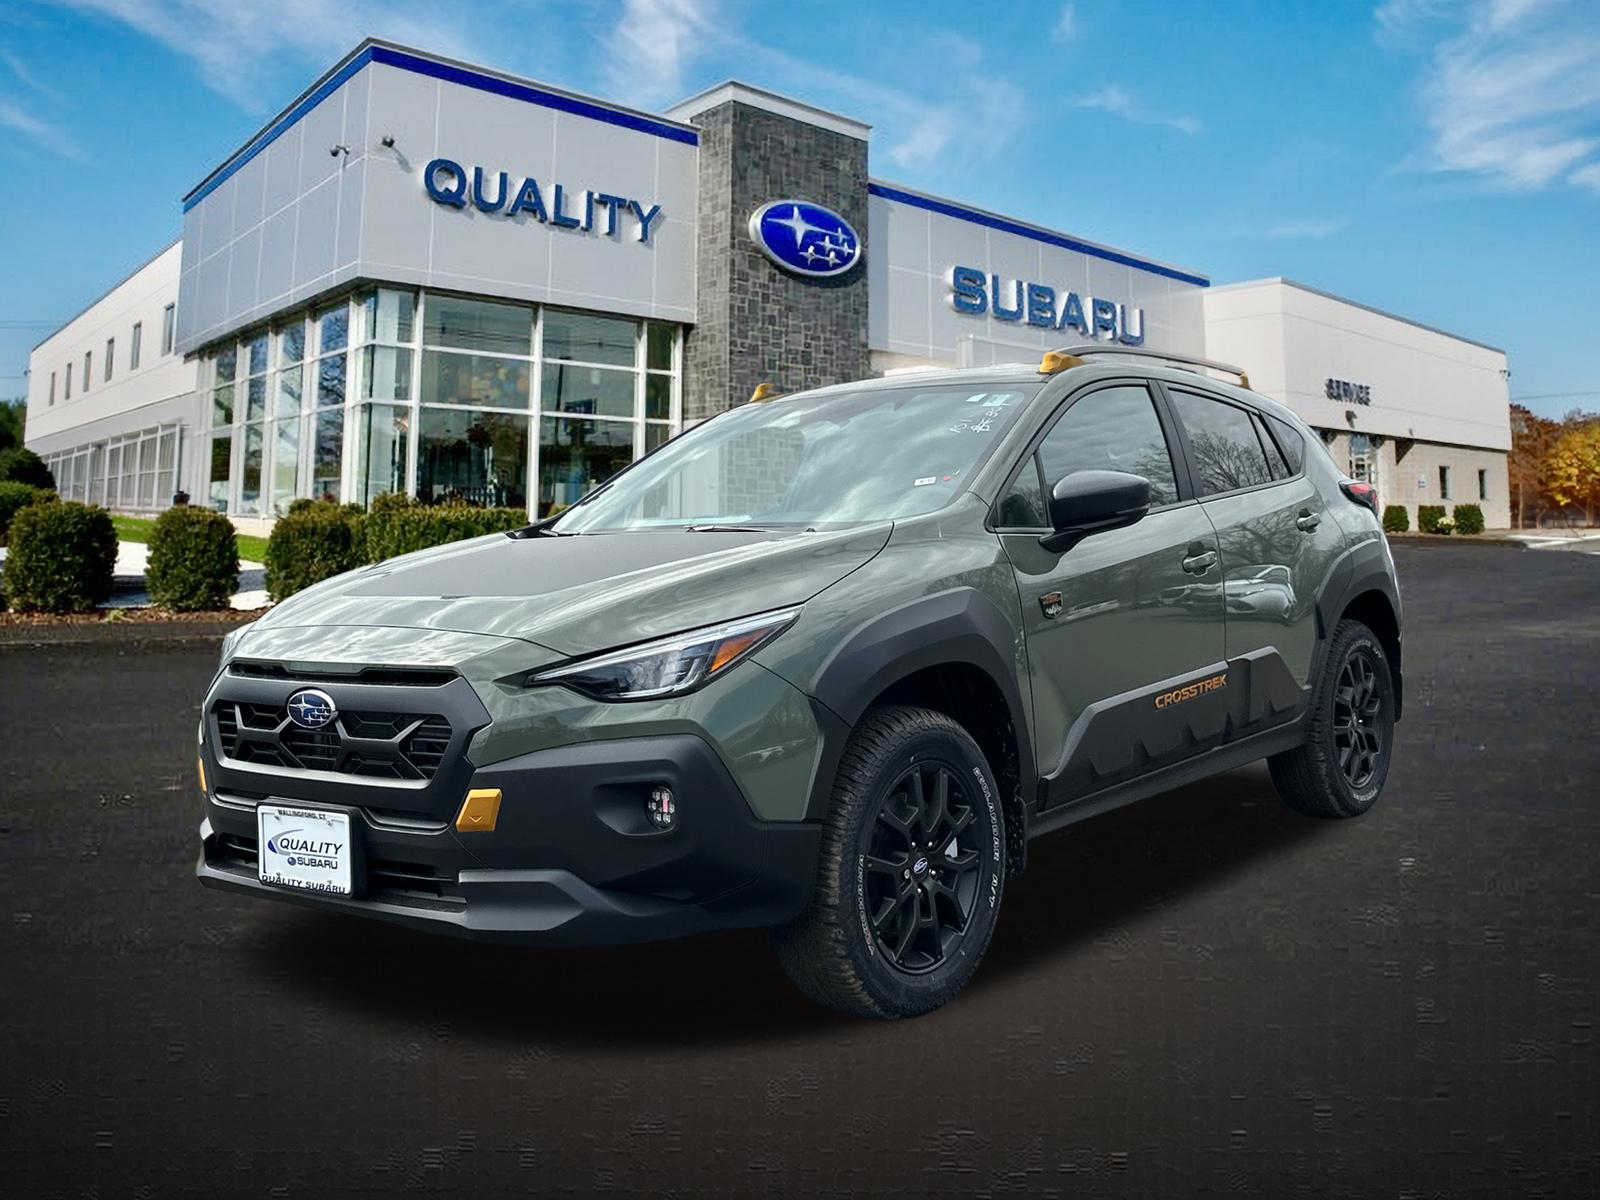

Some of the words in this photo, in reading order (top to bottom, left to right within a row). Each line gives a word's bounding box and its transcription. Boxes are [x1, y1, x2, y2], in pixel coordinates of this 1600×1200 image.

[424, 158, 662, 243] QUALITY
[949, 264, 1145, 347] SUBARU
[1325, 377, 1371, 406] SERVICE
[1154, 673, 1228, 709] CROSSTREK
[280, 837, 343, 855] QUALITY
[297, 856, 338, 870] SUBARU
[261, 874, 303, 888] QUALITY
[305, 881, 346, 894] SUBARU
